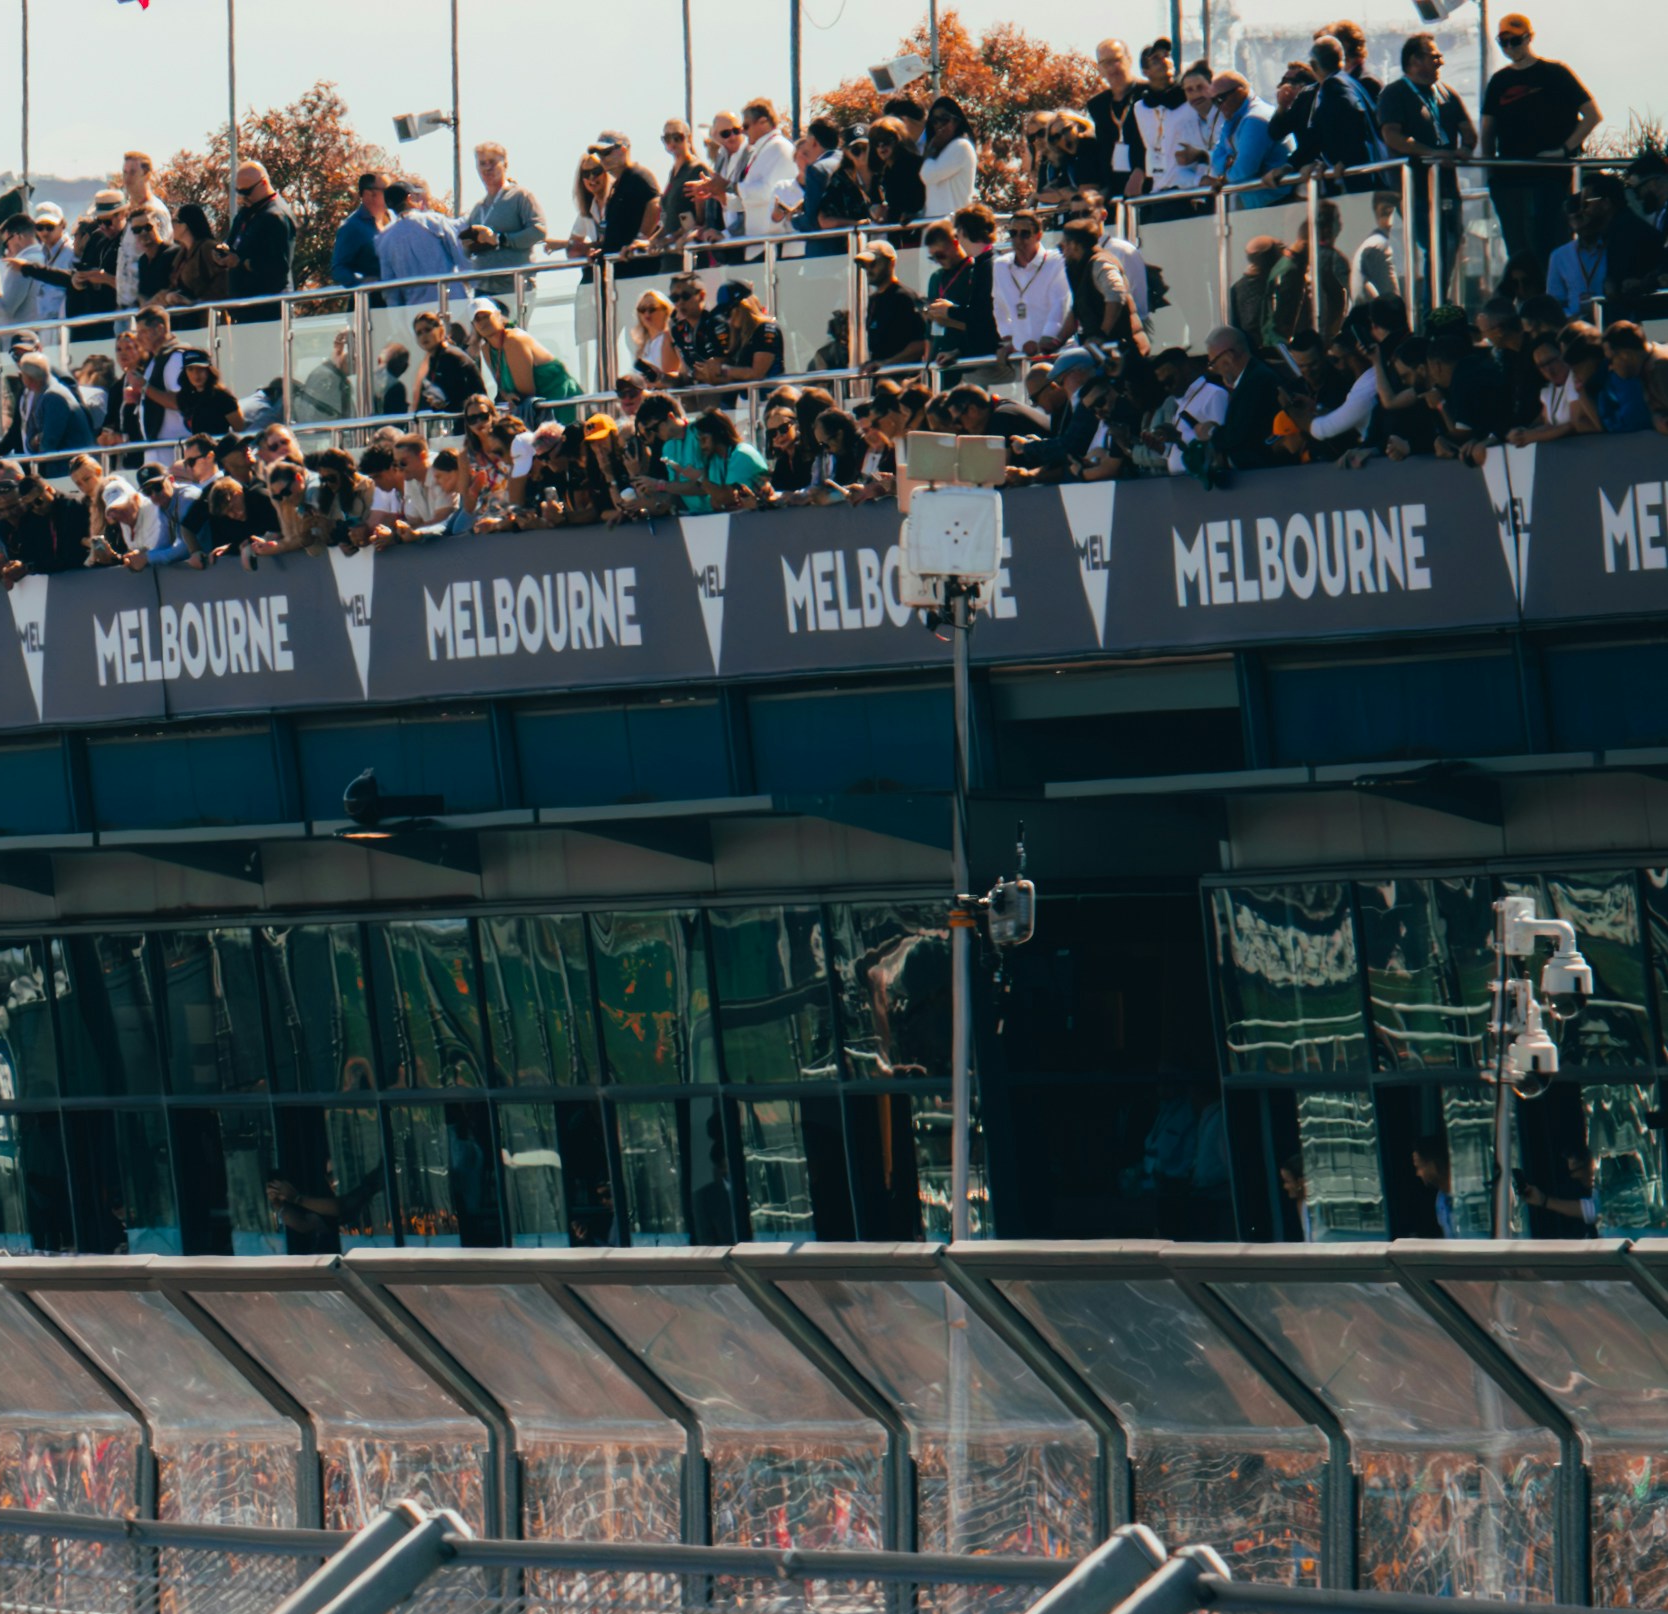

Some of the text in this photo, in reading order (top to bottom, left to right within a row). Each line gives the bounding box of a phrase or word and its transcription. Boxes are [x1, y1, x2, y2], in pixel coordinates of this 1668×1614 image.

[1073, 534, 1111, 571] MEL
[1172, 503, 1432, 608] MELBOURNE
[1598, 481, 1668, 573] ME
[340, 594, 372, 627] MEL
[423, 567, 643, 662] MELBOURNE
[692, 564, 726, 598] MEL
[781, 537, 1018, 634] MELBOE
[16, 621, 45, 652] MEL
[93, 595, 295, 687] MELBOURNE
